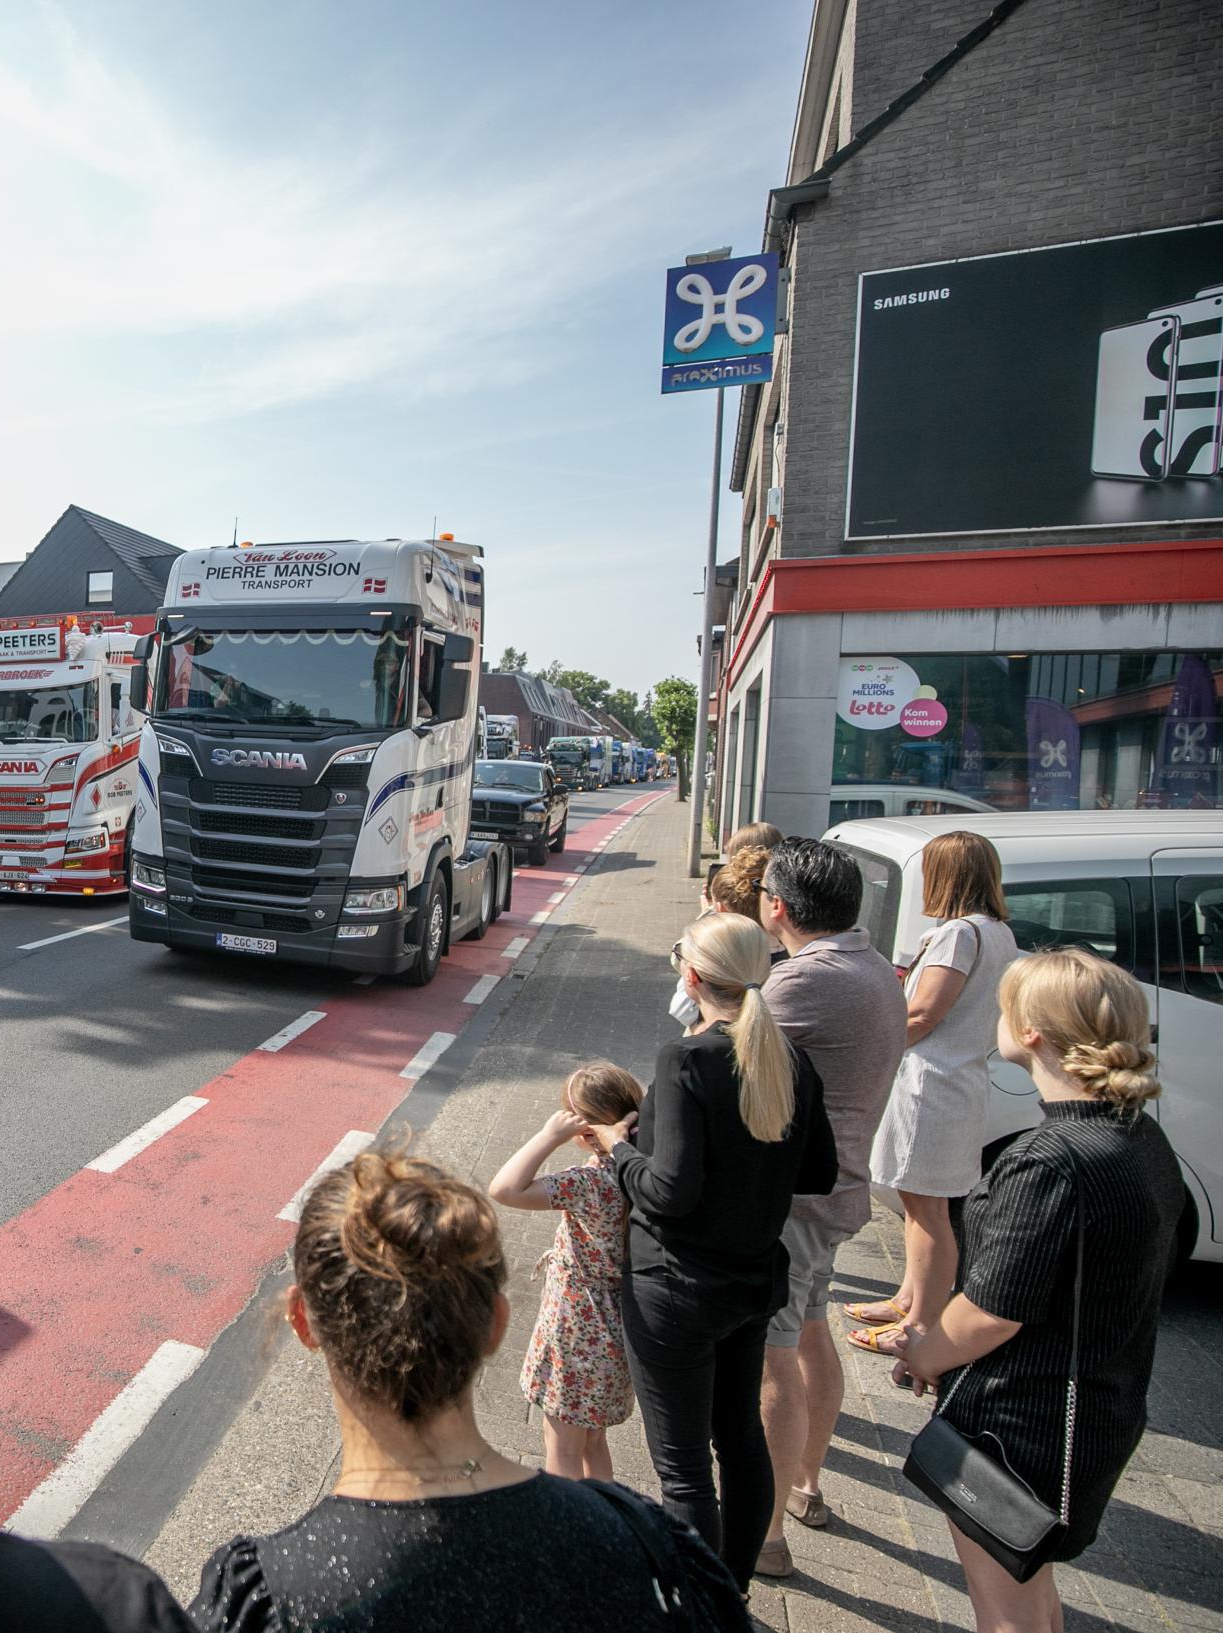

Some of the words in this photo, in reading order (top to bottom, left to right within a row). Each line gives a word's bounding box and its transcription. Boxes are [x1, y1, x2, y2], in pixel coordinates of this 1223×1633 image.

[874, 287, 950, 310] SAMSUNG
[671, 362, 762, 387] proximus
[244, 551, 275, 563] Van
[277, 549, 327, 561] Loon
[206, 565, 266, 580] PIERRE
[274, 562, 361, 578] MANSION
[241, 579, 313, 590] TRANSPORT
[16, 649, 47, 657] TRANSPORT
[905, 708, 928, 717] Kom
[904, 717, 942, 726] winnen
[210, 748, 308, 771] SCANIA
